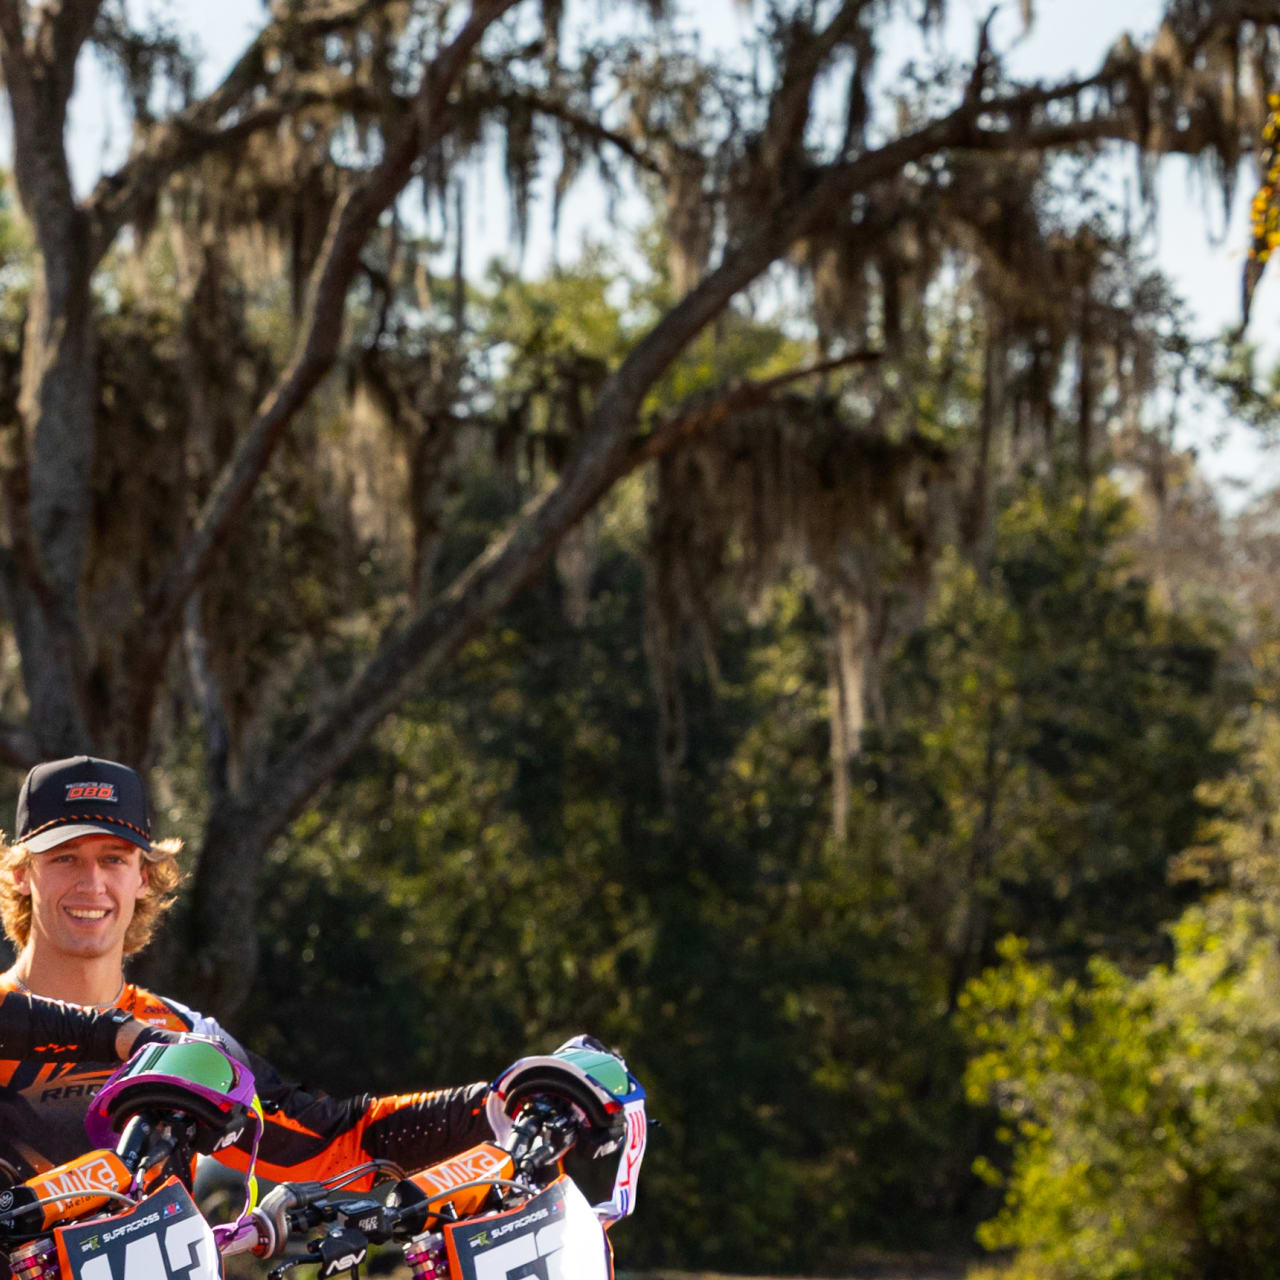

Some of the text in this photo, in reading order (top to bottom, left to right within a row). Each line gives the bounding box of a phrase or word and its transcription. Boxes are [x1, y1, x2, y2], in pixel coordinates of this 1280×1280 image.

[67, 787, 114, 799] DBD
[213, 1128, 244, 1152] ASV
[103, 1212, 160, 1244] SUPERCROSS
[325, 1248, 367, 1275] ASV
